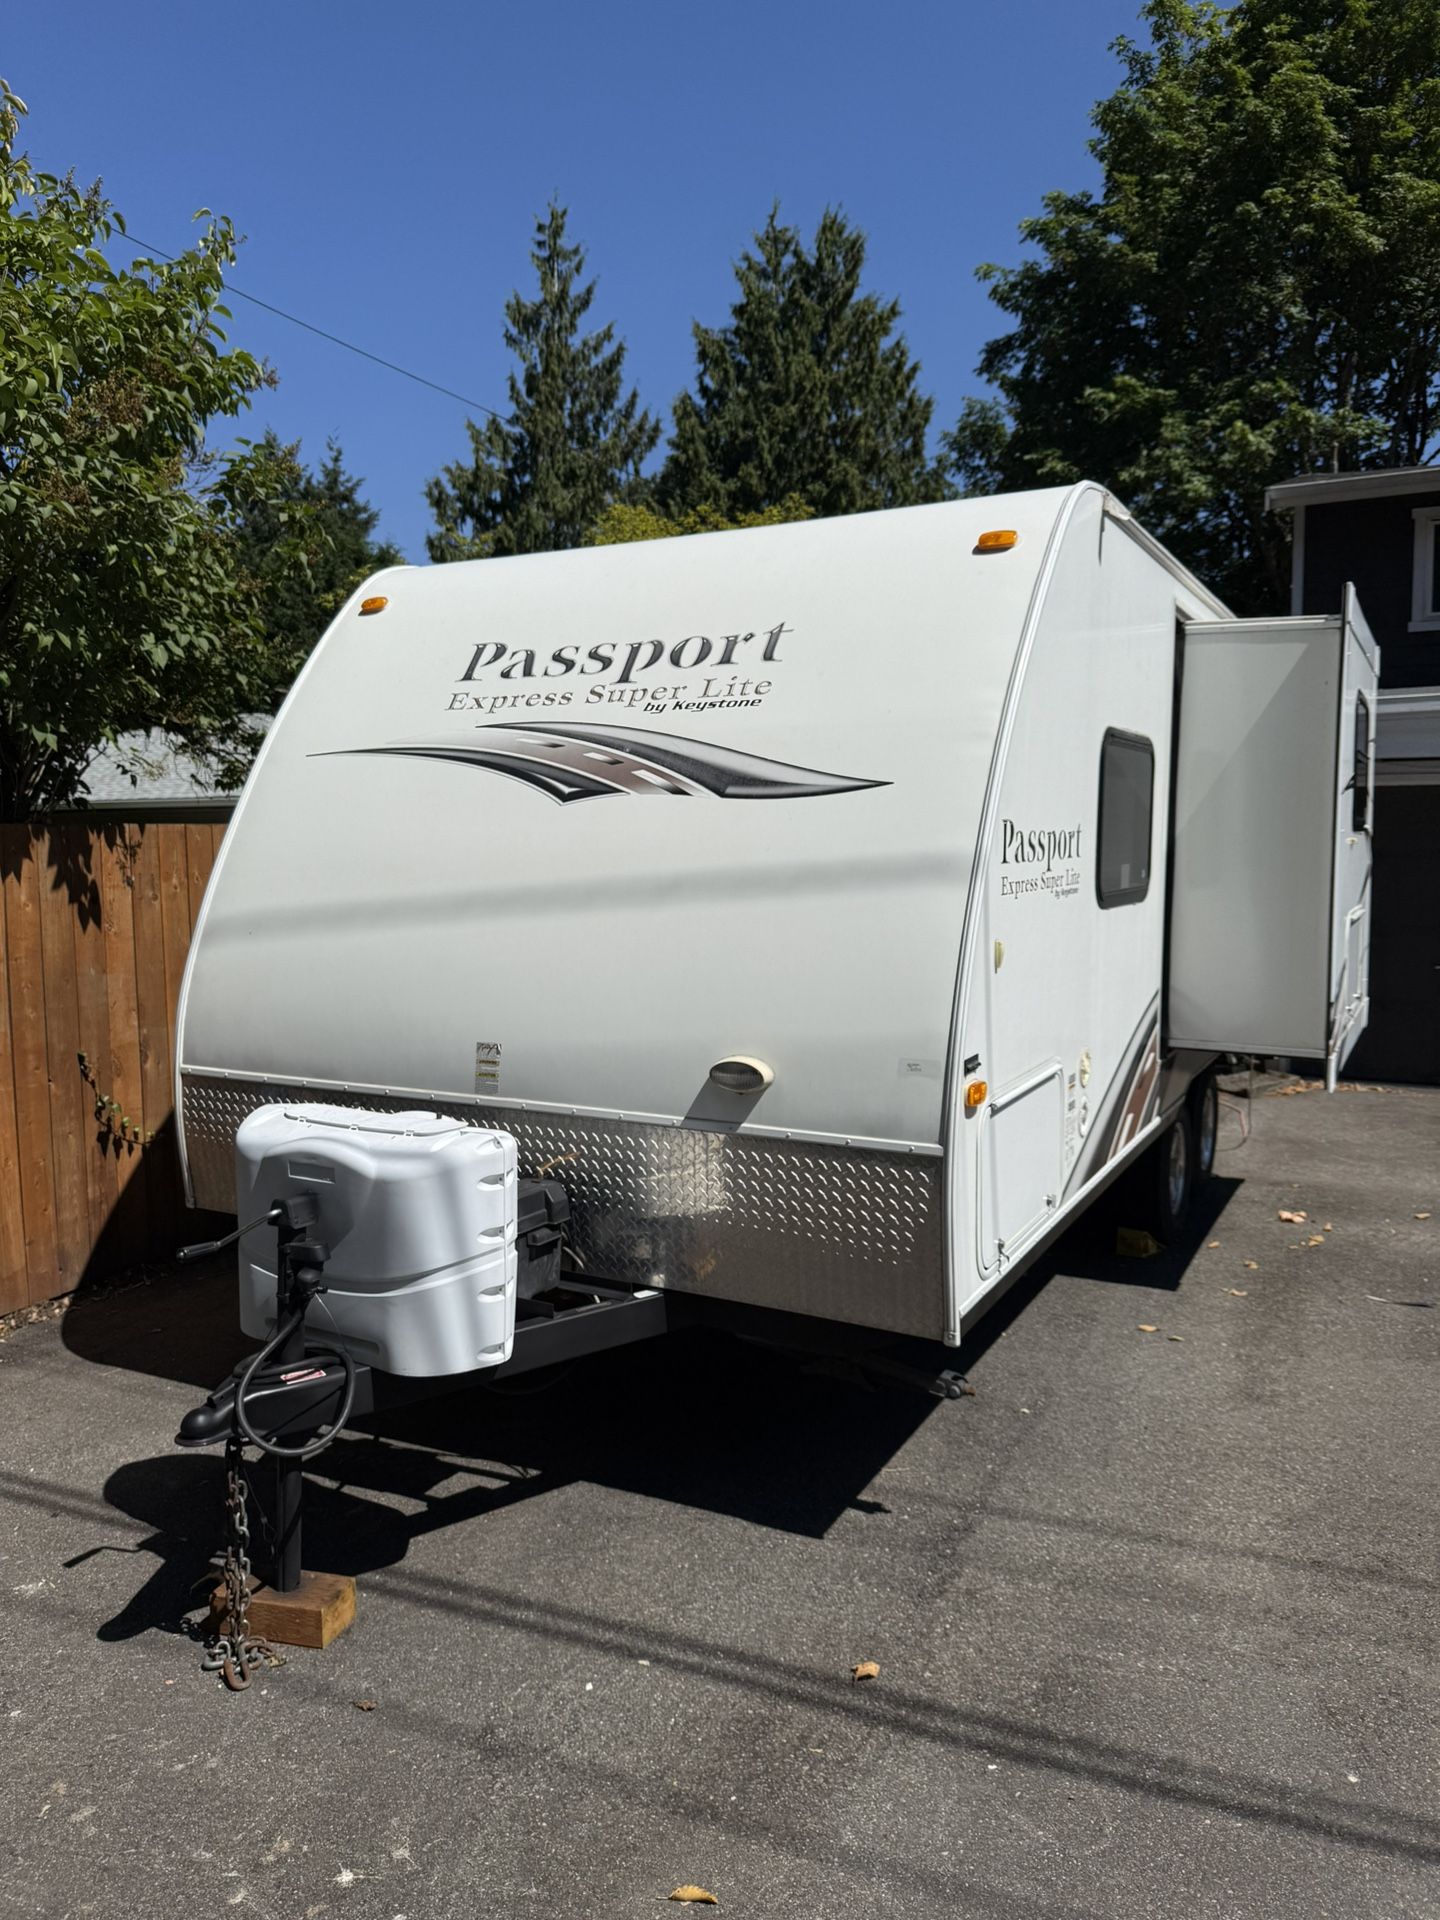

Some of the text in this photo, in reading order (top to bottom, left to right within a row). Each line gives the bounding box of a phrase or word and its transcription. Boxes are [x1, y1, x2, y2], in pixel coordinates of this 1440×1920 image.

[457, 621, 794, 684] Passport
[445, 675, 772, 714] Express Super Lite
[643, 698, 762, 714] by Keystone
[1001, 819, 1082, 872] Passport
[1001, 876, 1038, 899] Express
